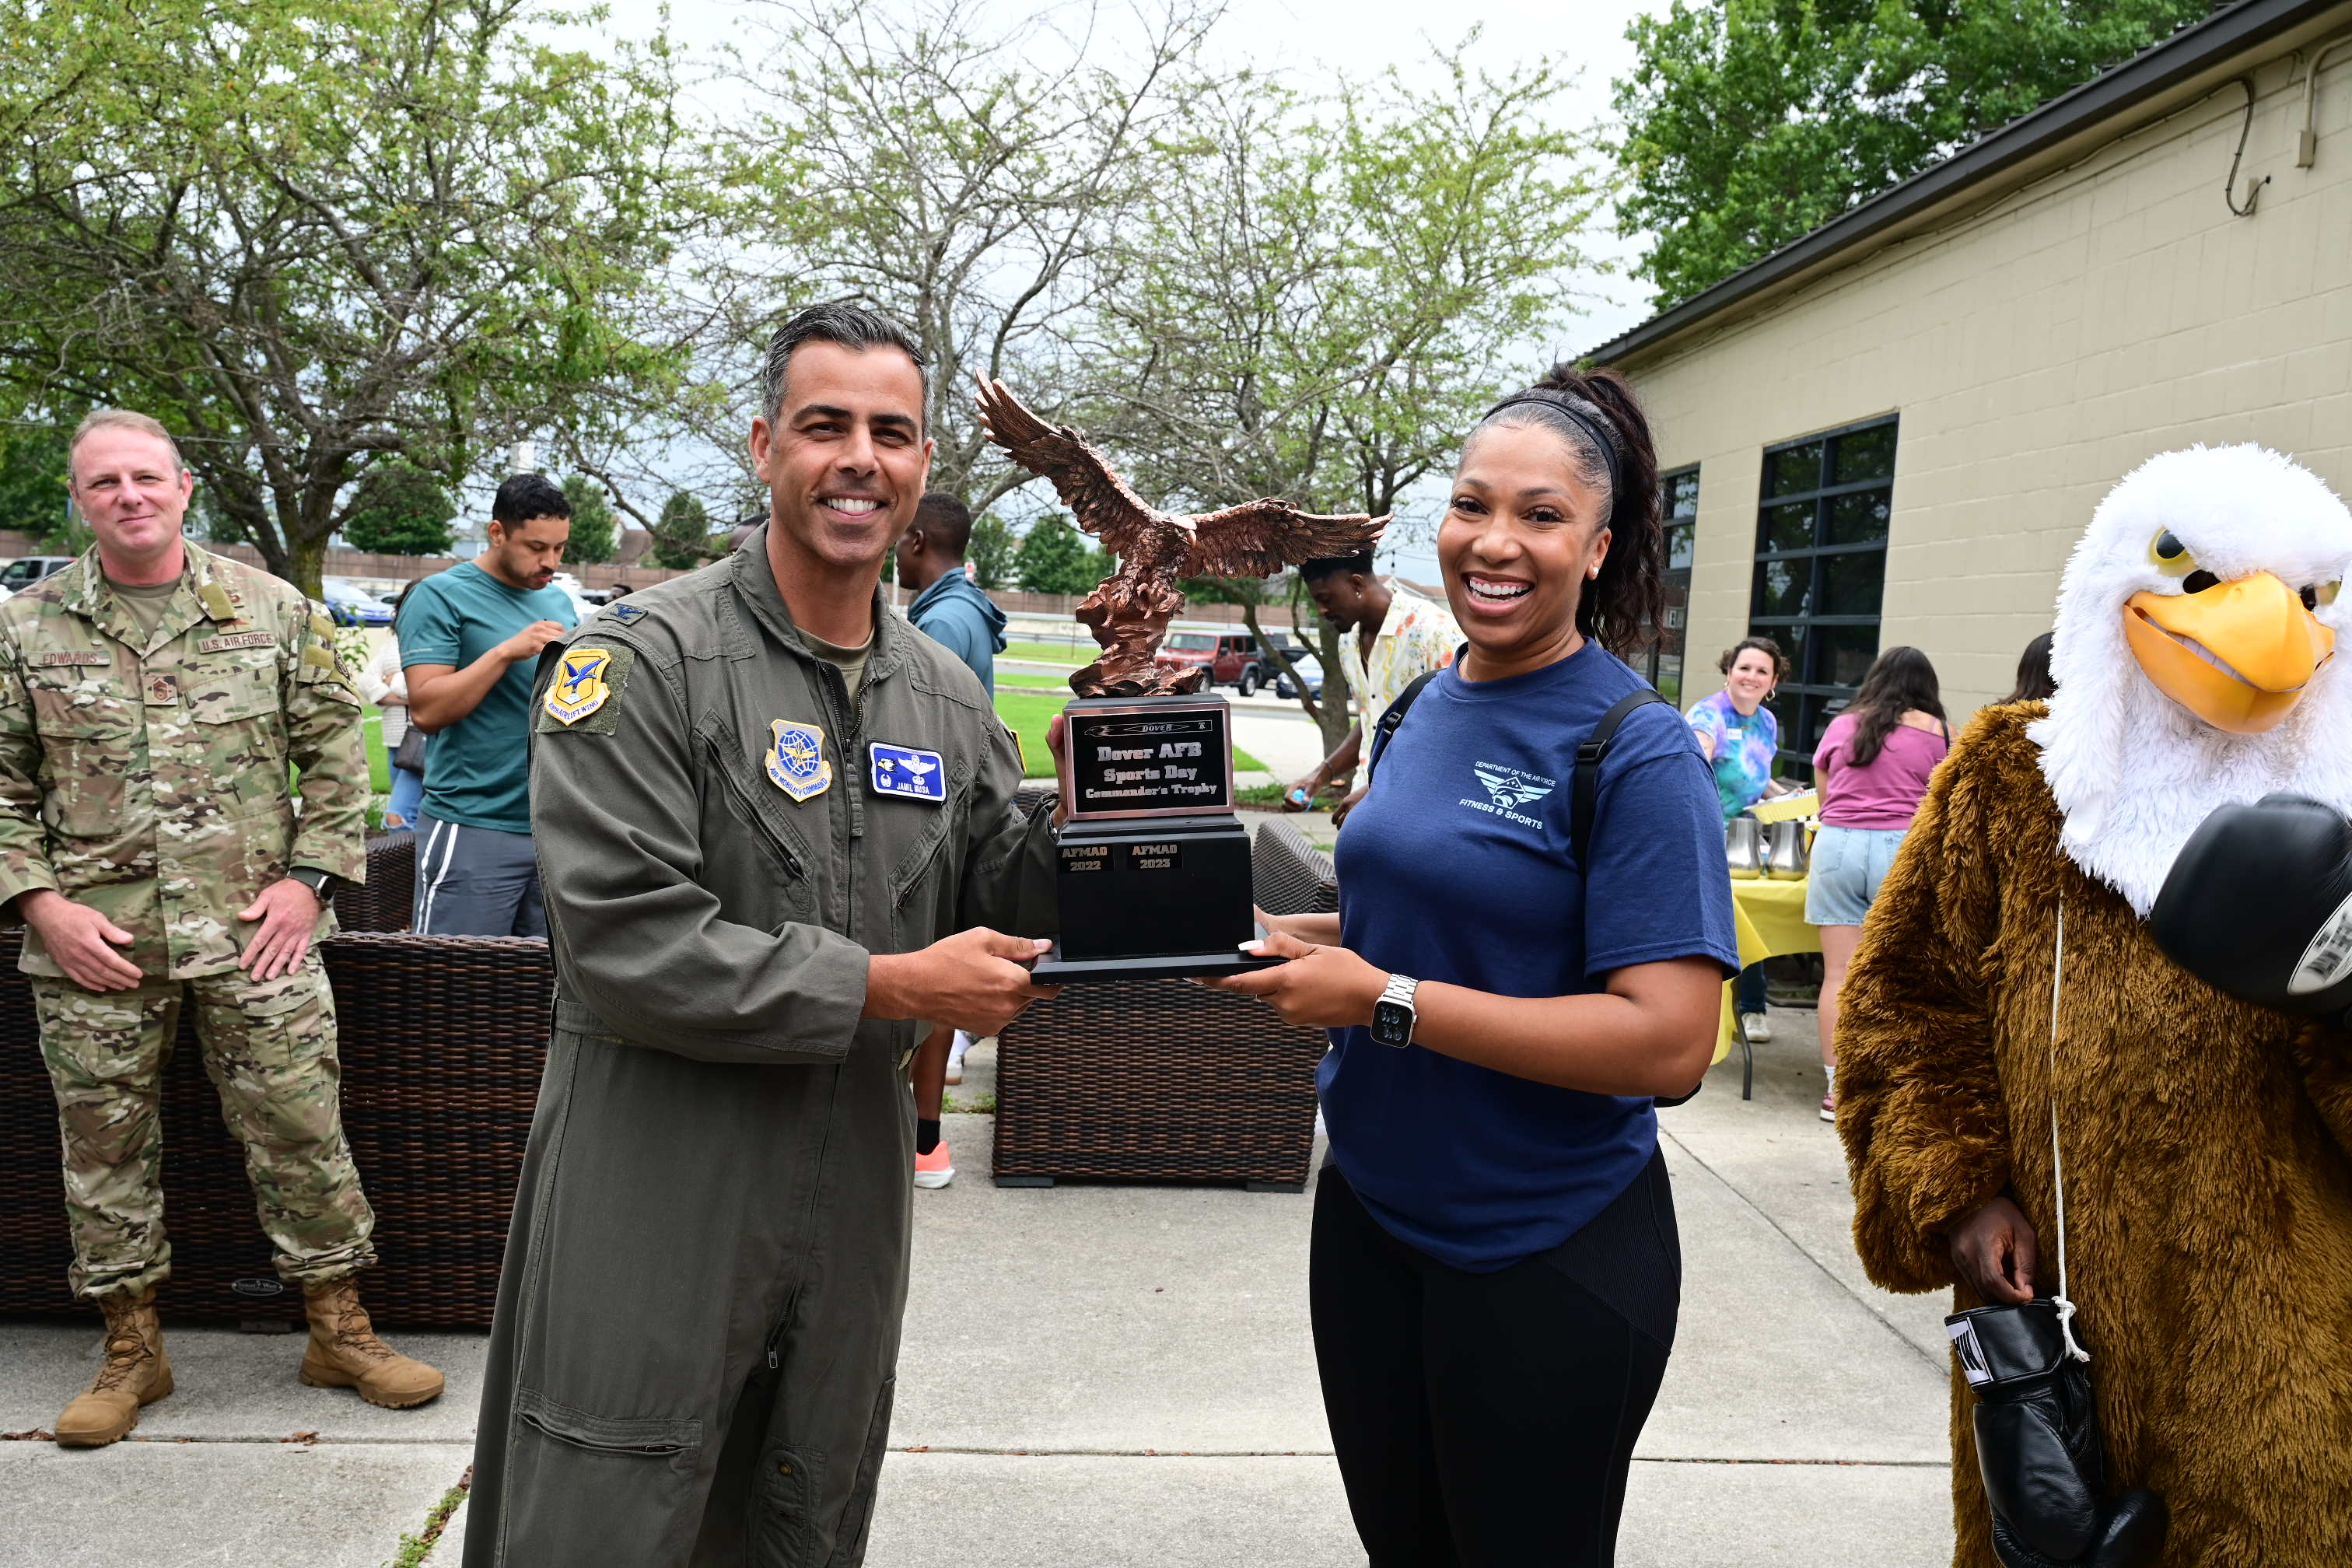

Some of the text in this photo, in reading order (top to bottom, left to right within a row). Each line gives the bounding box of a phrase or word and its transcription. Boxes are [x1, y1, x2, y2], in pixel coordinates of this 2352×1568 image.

[202, 633, 273, 650] U.S. AIR FORCE
[43, 653, 97, 665] EDWARDS
[581, 699, 599, 713] WING
[1142, 724, 1173, 733] DOVER
[1097, 742, 1202, 761] Dover AFB
[1104, 765, 1198, 784] Sports Day
[1475, 761, 1511, 774] DEPARTMENT
[1521, 772, 1532, 780] THE
[1540, 776, 1556, 786] FORCE
[779, 776, 802, 796] MOBILITY
[803, 778, 828, 795] COMMAND
[897, 782, 913, 792] JAMIL
[1085, 783, 1217, 799] Commander's Trophy
[1459, 798, 1495, 813] FITNESS
[1505, 810, 1543, 830] SPORTS
[1069, 861, 1101, 871] 2022
